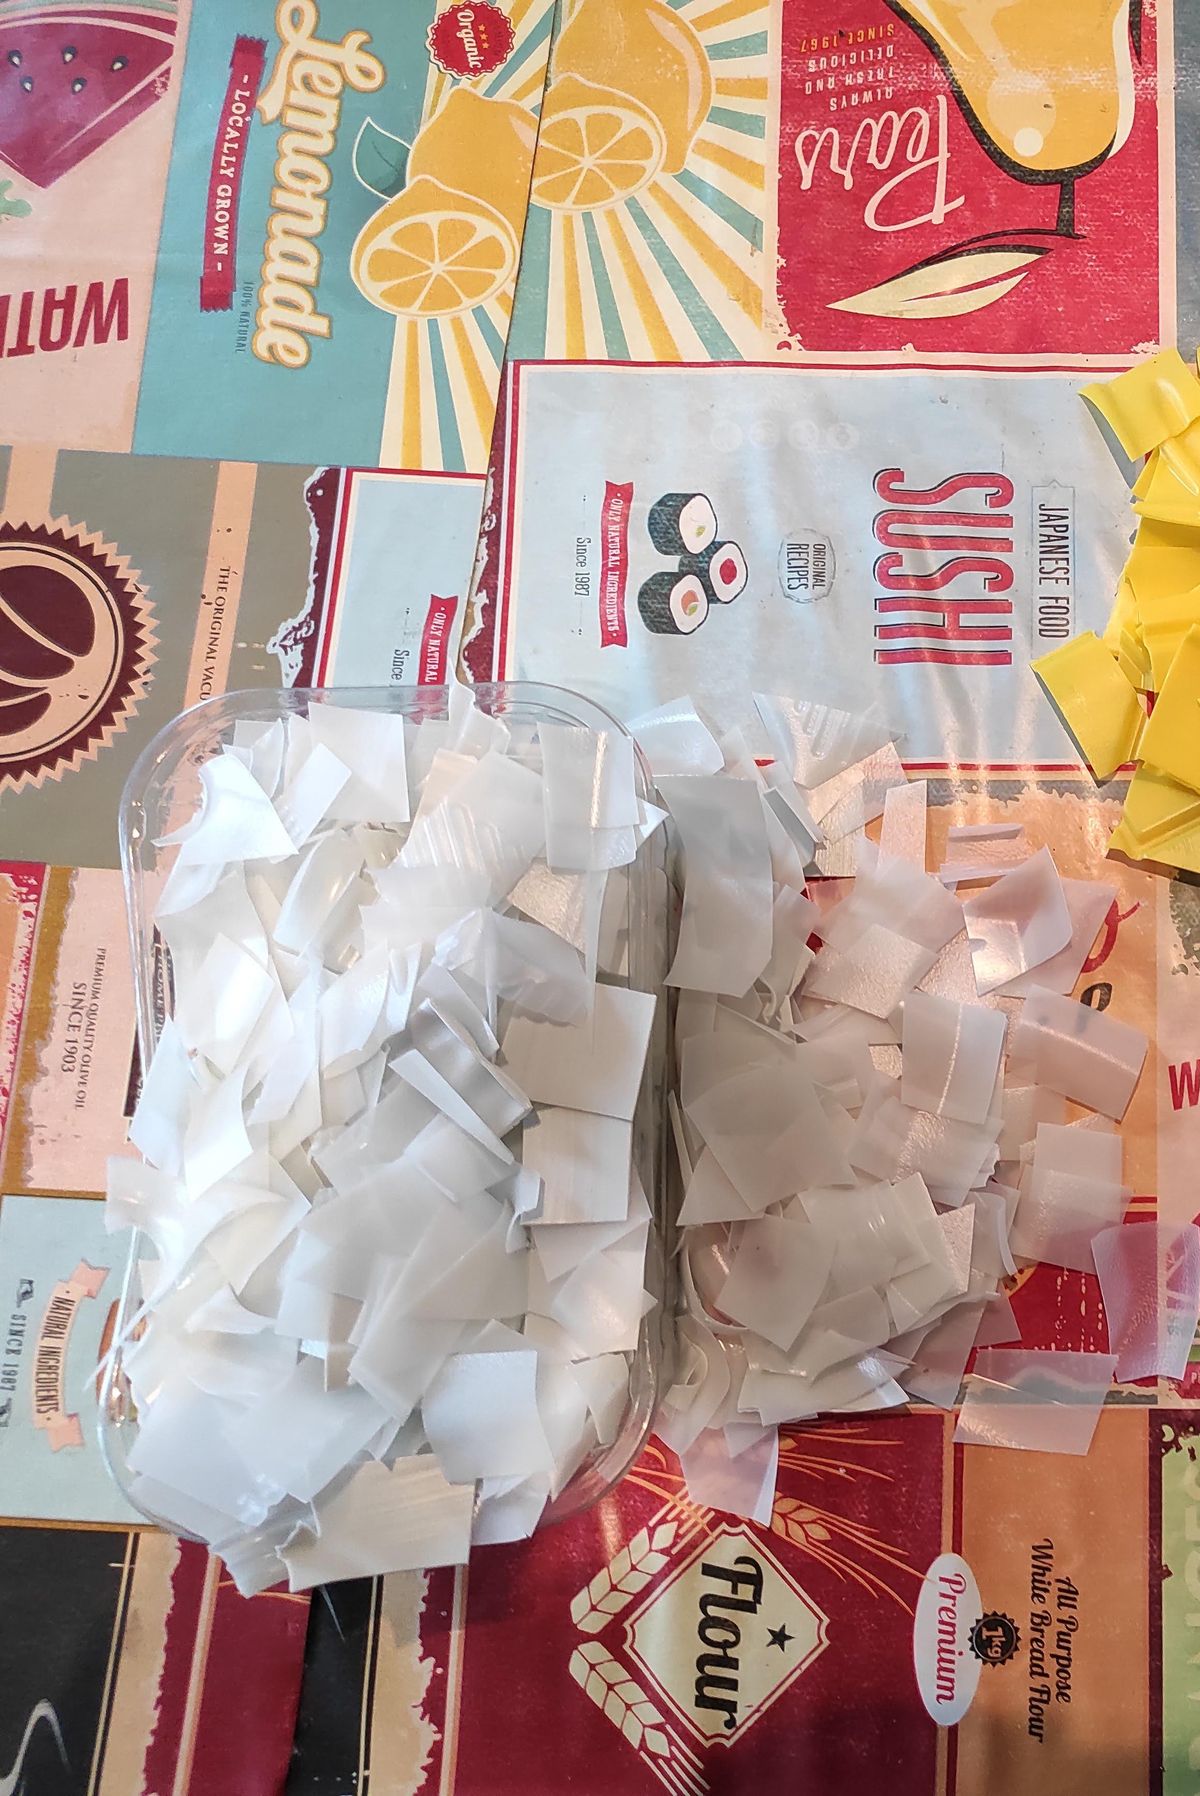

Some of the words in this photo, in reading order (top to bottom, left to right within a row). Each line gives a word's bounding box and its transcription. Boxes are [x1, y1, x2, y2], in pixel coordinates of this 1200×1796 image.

[456, 9, 485, 69] Organic
[801, 36, 838, 53] 1967
[848, 24, 894, 44] SINCE
[808, 45, 894, 72] DELICIOUS
[845, 66, 894, 86] FRESH
[805, 75, 836, 95] AND
[829, 87, 893, 111] ALWAYS
[219, 89, 250, 178] LOCALLY
[251, 0, 387, 370] Lemonade
[795, 95, 965, 231] Pears
[214, 184, 232, 255] GROWN
[241, 281, 255, 307] 100%
[235, 311, 251, 353] NATURAL
[607, 498, 623, 521] ONLY
[576, 537, 591, 567] Since
[608, 524, 622, 568] NATURAL
[812, 543, 826, 590] ORIGINAL
[872, 467, 1014, 666] SUSHI
[1038, 503, 1070, 586] JAPANESE
[218, 566, 231, 592] THE
[575, 571, 590, 597] 1987
[786, 543, 809, 591] RECIPES
[205, 596, 226, 662] ORIGINAL
[430, 612, 446, 636] ONLY
[1038, 596, 1070, 639] FOOD
[391, 649, 410, 681] Since
[425, 638, 441, 683] NATURAL
[90, 948, 107, 1000] PREMIUM
[66, 982, 87, 1032] SINCE
[83, 1003, 99, 1051] QUALITY
[61, 1038, 79, 1073] 1903
[77, 1053, 92, 1086] OLIVE
[75, 1089, 87, 1110] OIL
[5, 1314, 27, 1355] SINCE
[41, 1296, 76, 1340] NATURAL
[35, 1345, 62, 1413] INGREDIENTS
[1031, 1537, 1053, 1605] White
[1055, 1576, 1079, 1611] All
[694, 1555, 764, 1730] Flour
[936, 1573, 967, 1705] Premium
[981, 1625, 1007, 1659] 1kg
[1029, 1610, 1053, 1679] Bread
[1055, 1616, 1079, 1704] Purpose
[1028, 1684, 1051, 1744] Flour
